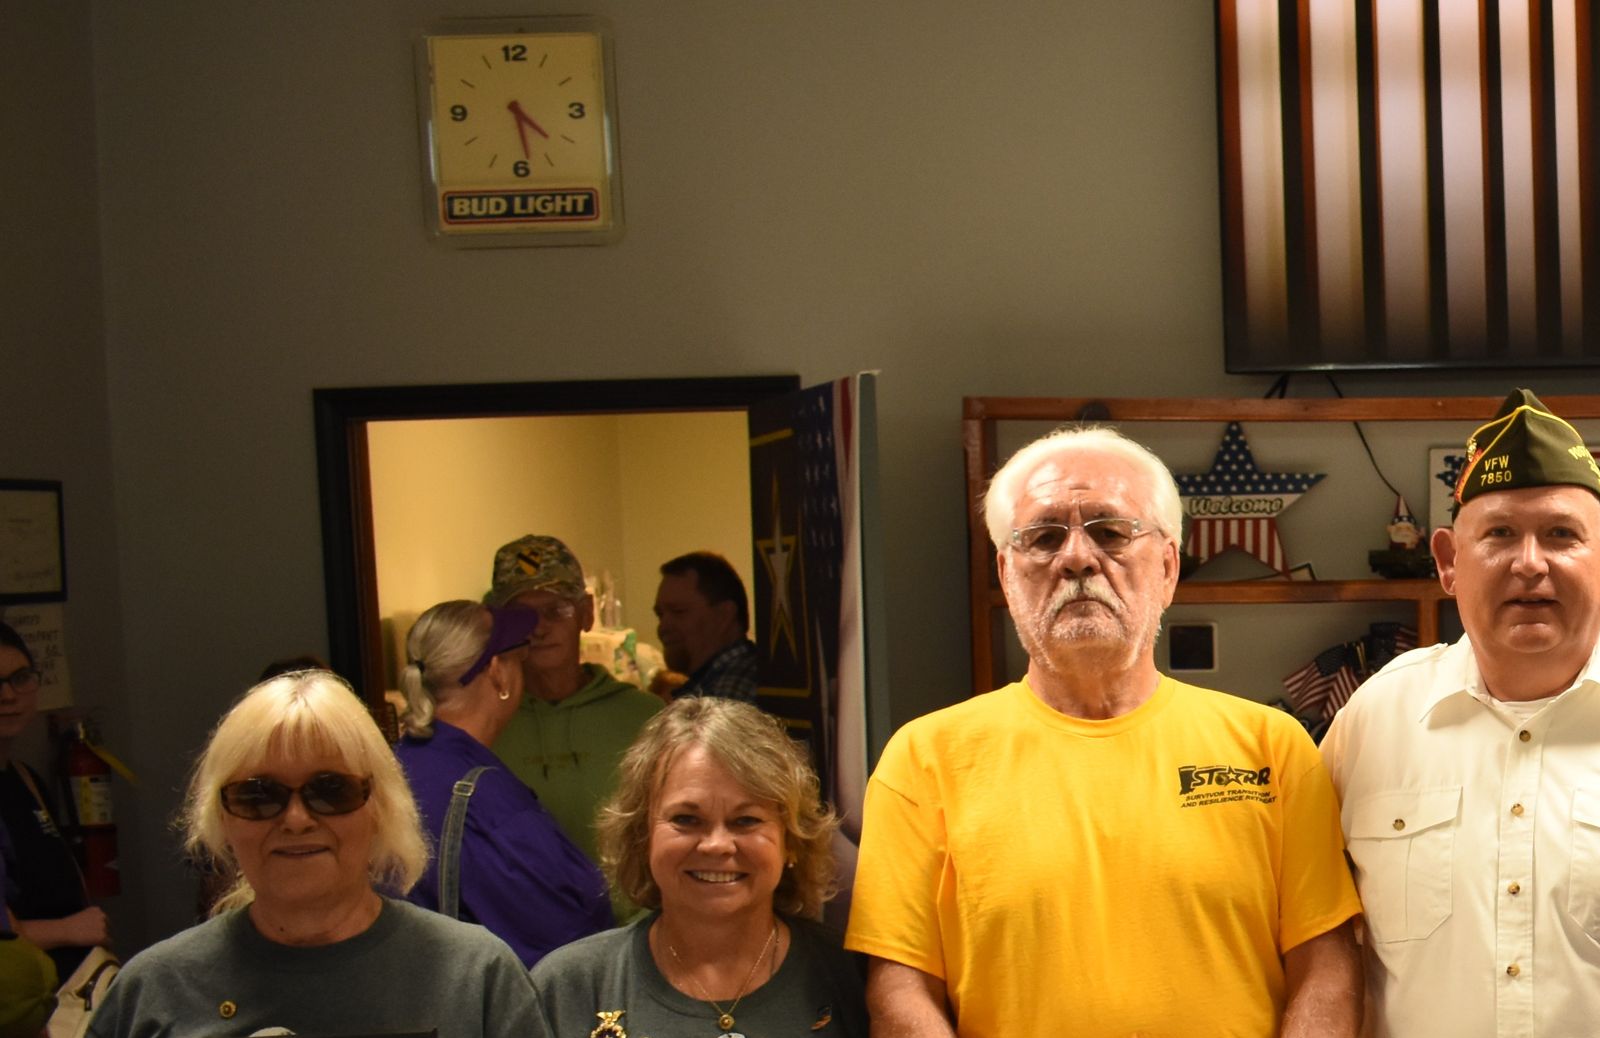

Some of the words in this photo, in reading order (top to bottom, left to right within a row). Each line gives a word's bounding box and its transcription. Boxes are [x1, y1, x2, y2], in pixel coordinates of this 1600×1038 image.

[502, 45, 527, 62] 12
[450, 104, 468, 122] 9
[568, 102, 586, 120] 3
[512, 160, 531, 178] 6
[452, 198, 508, 217] BUD
[512, 194, 589, 215] LIGHT
[1484, 454, 1510, 472] VFW
[1480, 470, 1512, 487] 7850
[1189, 496, 1284, 516] Welcome
